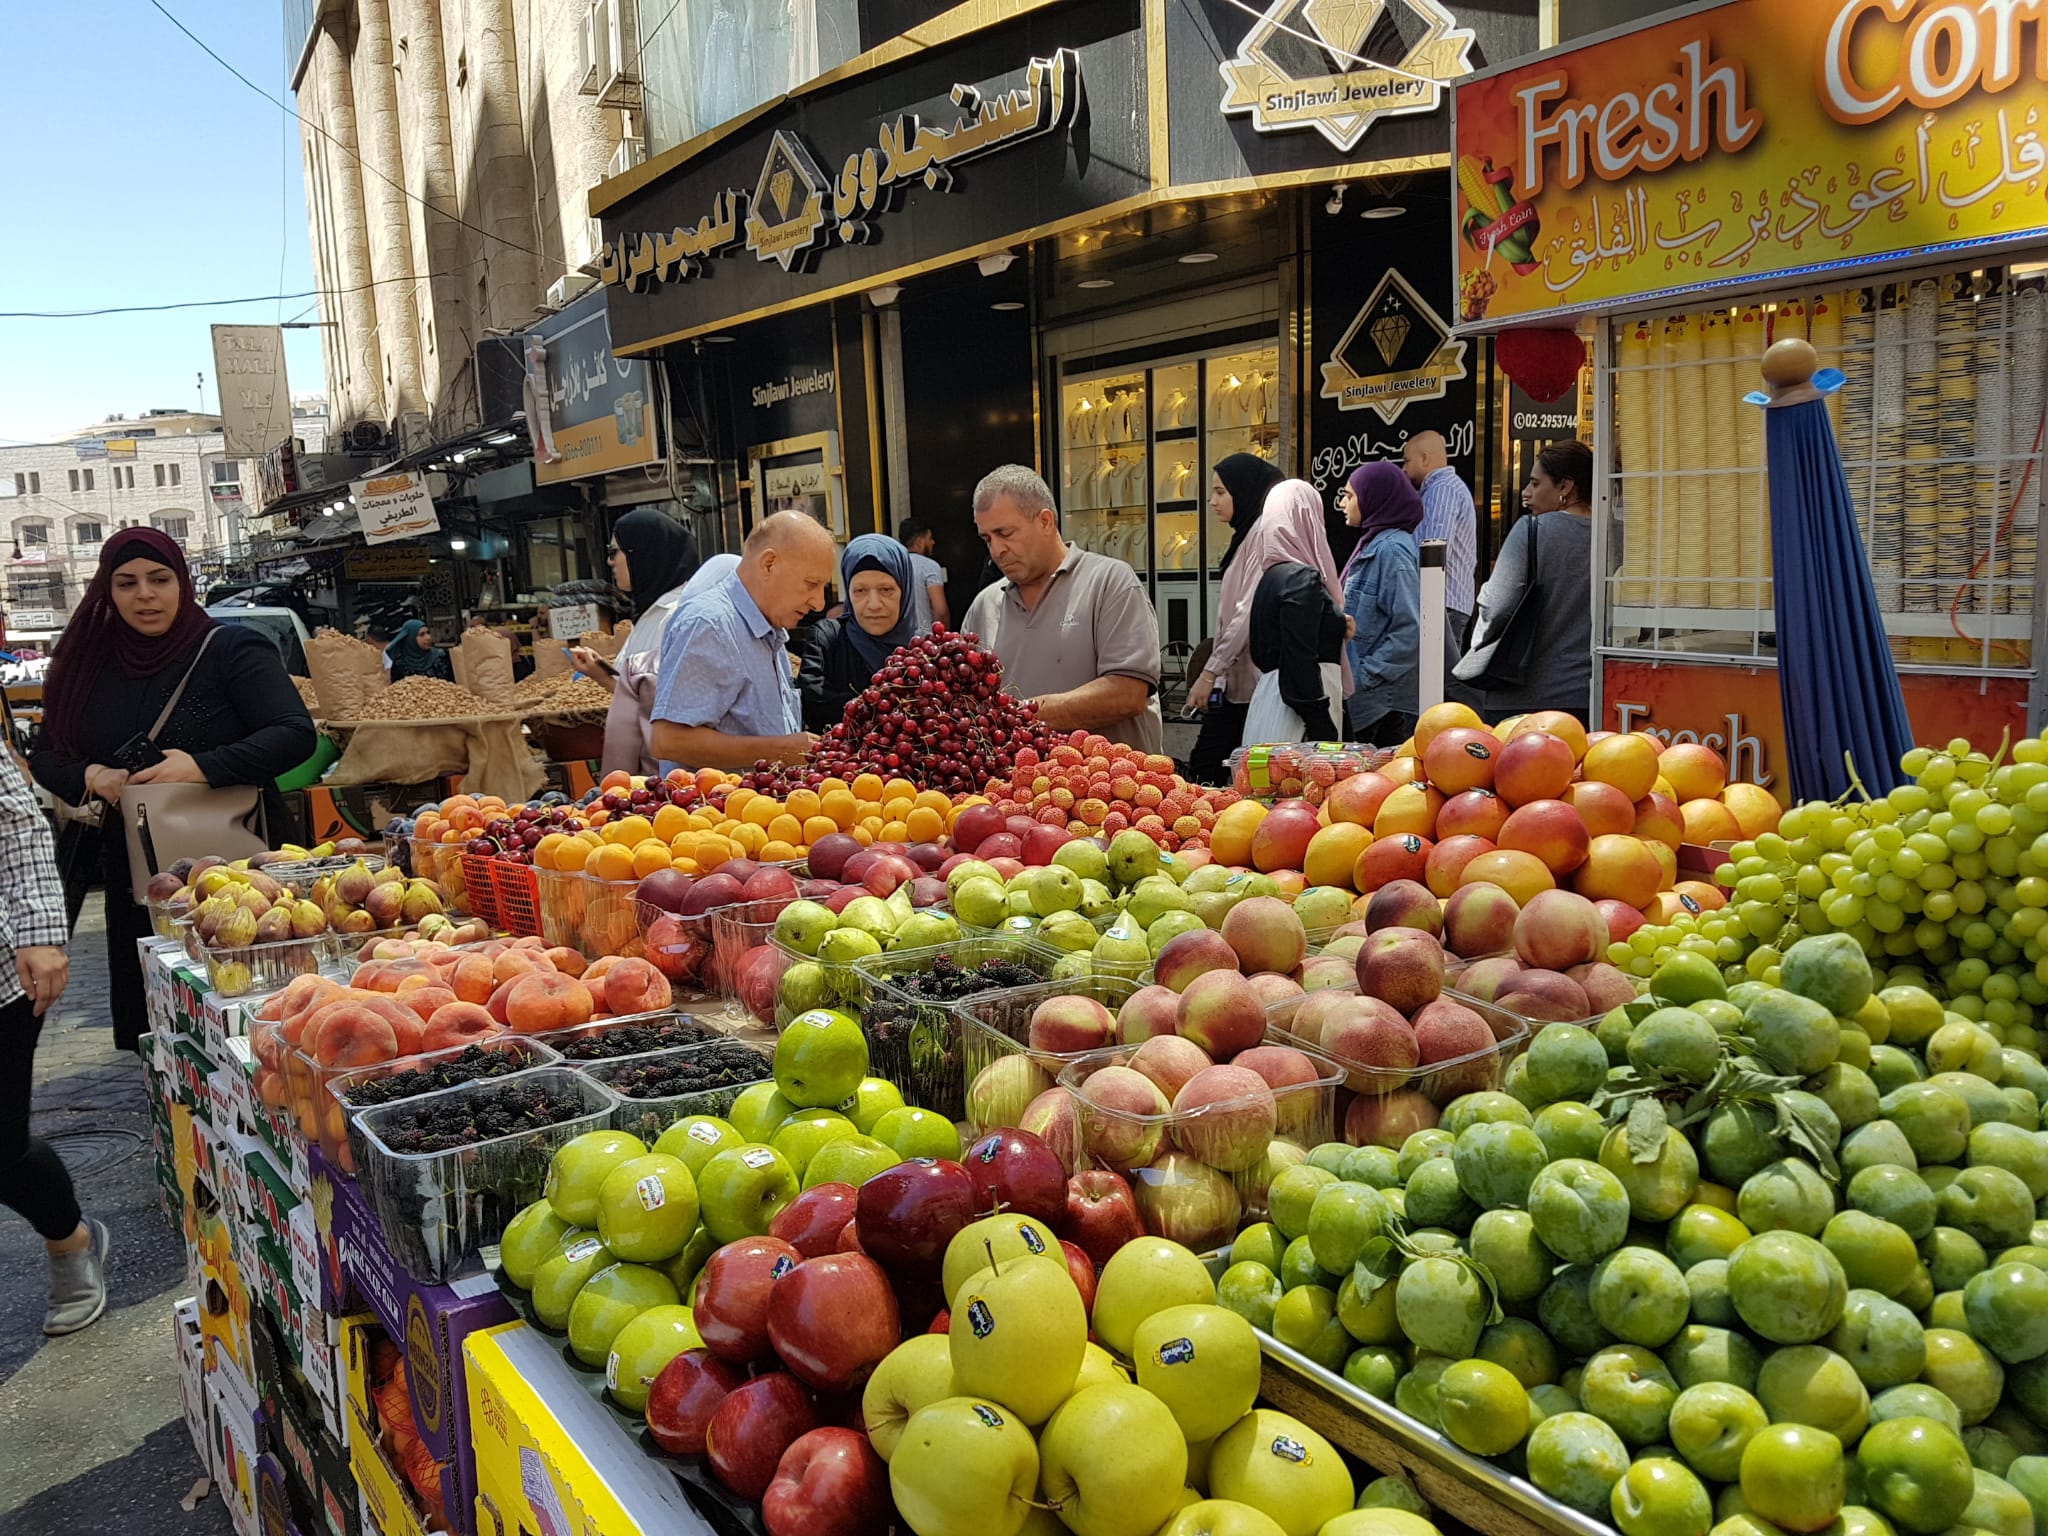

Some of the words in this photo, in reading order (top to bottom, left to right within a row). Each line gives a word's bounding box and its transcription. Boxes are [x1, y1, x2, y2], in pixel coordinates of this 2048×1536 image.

[1266, 86, 1338, 112] Sinjlawi
[1342, 79, 1425, 102] Jewelery
[1515, 38, 1756, 192] Fresh
[1823, 0, 2048, 116] Cor
[834, 47, 1080, 244] السنجلاوي
[600, 187, 752, 295] للمجوهرات
[223, 357, 277, 374] MALL
[751, 376, 790, 409] Sinjlawi
[790, 368, 834, 397] Jewelery
[1346, 382, 1387, 398] Sinjlawi
[1389, 376, 1437, 392] Jewelery
[1311, 420, 1474, 491] النجلاوي
[1614, 701, 1773, 788] Fsh
